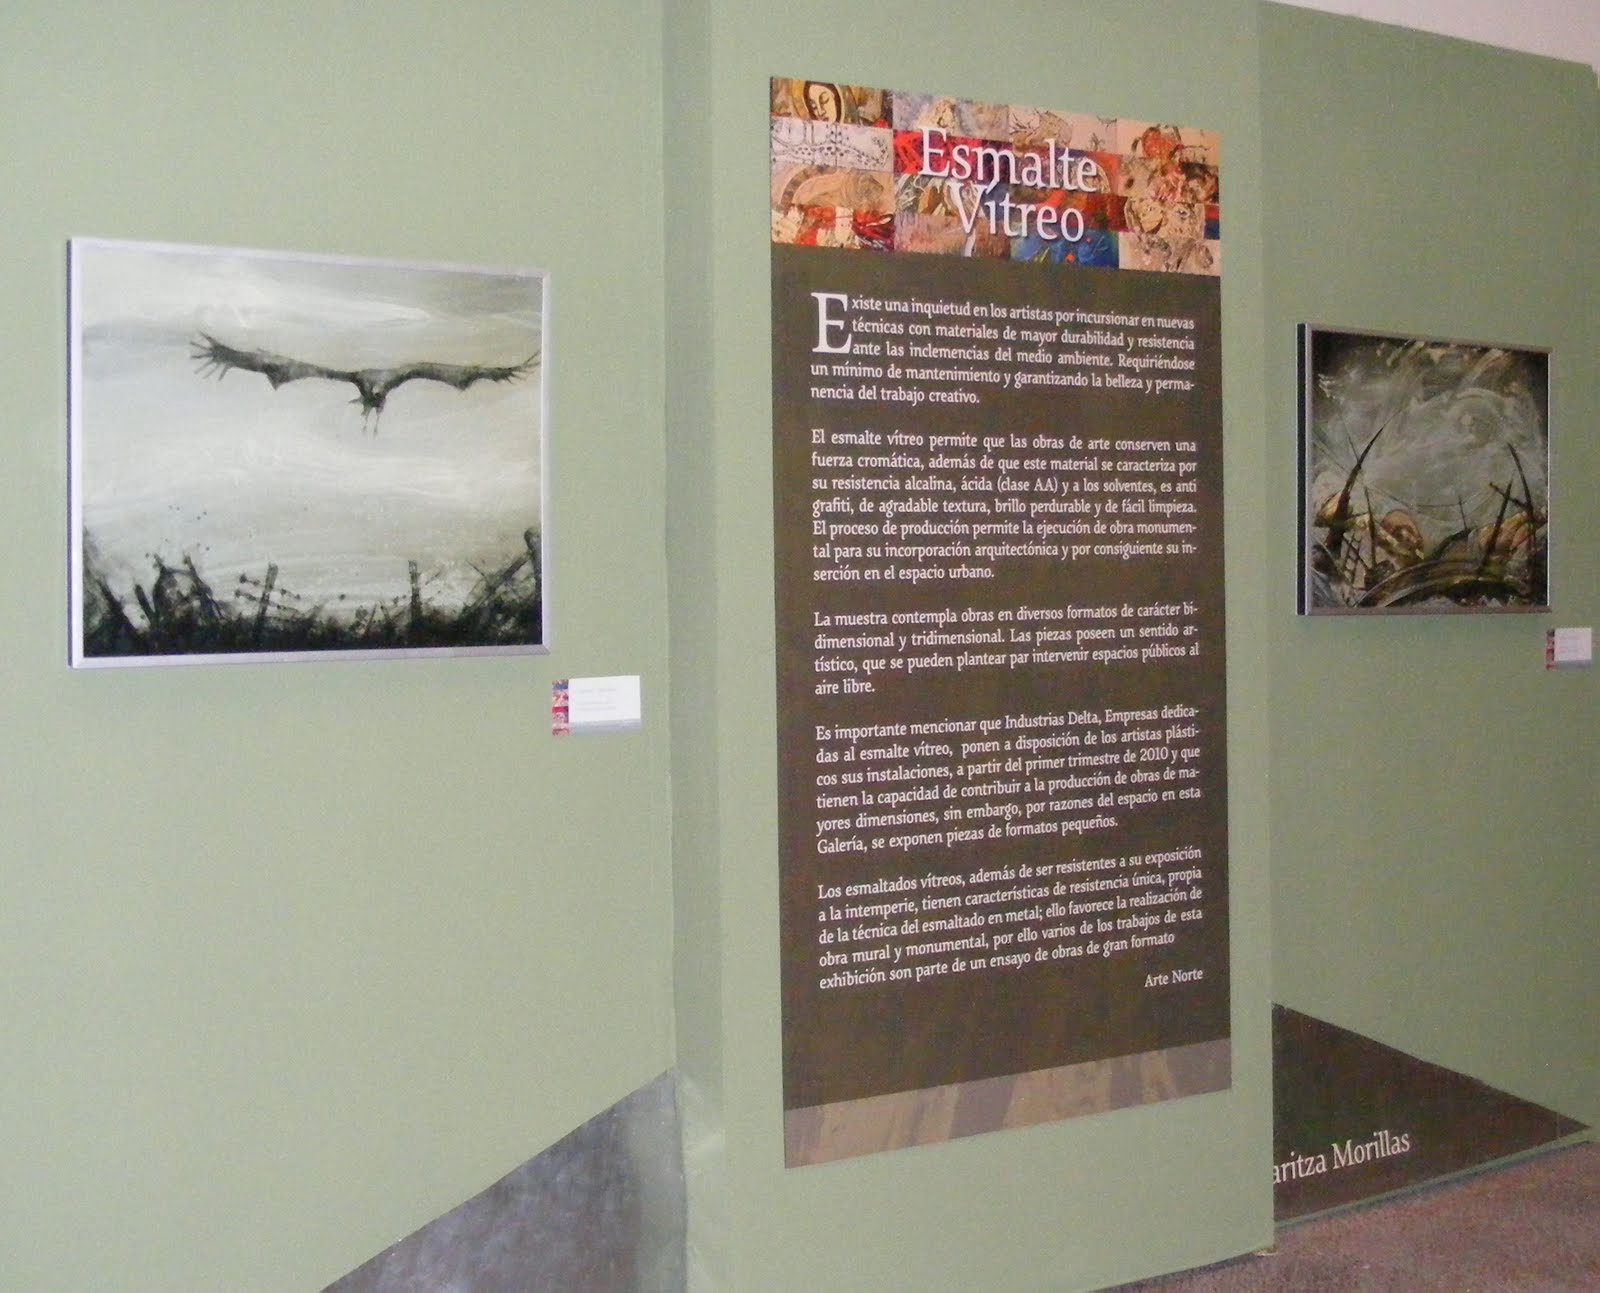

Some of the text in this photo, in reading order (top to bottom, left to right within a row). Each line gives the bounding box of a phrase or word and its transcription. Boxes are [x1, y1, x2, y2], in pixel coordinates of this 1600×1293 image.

[918, 127, 1097, 193] Esmalte
[884, 300, 909, 312] una
[911, 299, 970, 318] inquietud
[973, 305, 988, 316] en
[991, 302, 1007, 318] los
[1009, 306, 1053, 321] artistas
[1054, 311, 1075, 326] por
[1076, 308, 1139, 326] incursionar
[1141, 316, 1155, 327] en
[1156, 318, 1194, 329] nuevas
[852, 316, 1194, 351] técnicas con materiales de mayor durabilidad y resistencia
[852, 341, 1195, 372] ante las inclemencias del medio ambiente. Requiriéndose
[810, 364, 828, 375] un
[832, 361, 882, 377] mínimo
[887, 364, 901, 378] de
[905, 367, 1000, 382] mantenimiento
[1004, 373, 1011, 388] y
[1014, 370, 1088, 388] garantizando
[1091, 372, 1102, 386] la
[1105, 373, 1143, 388] belleza
[1146, 379, 1152, 393] y
[810, 384, 979, 406] nencia del trabajo creativo.
[811, 429, 1196, 452] El esmalte vítreo permite que las obras de arte conserven una
[811, 452, 1197, 476] fuerza cromática, además de que este material se caracteriza por
[812, 520, 826, 535] El
[829, 524, 878, 540] proceso
[882, 520, 897, 534] de
[900, 520, 969, 540] producción
[972, 520, 1019, 539] permite
[1023, 520, 1033, 534] la
[1037, 519, 1090, 539] ejecución
[1093, 520, 1106, 534] de
[1110, 520, 1133, 533] obra
[813, 564, 994, 584] serción en el espacio urbano.
[814, 612, 831, 626] La
[834, 612, 888, 625] muestra
[892, 608, 957, 628] contempla
[961, 607, 994, 622] obras
[998, 610, 1013, 621] en
[1017, 606, 1063, 620] diversos
[1067, 605, 1117, 619] formatos
[1121, 603, 1133, 617] de
[1137, 602, 1180, 616] carácter
[814, 642, 1199, 675] tístico, que se pueden plantear par intervenir espacios públicos al
[815, 679, 875, 694] aire libre.
[815, 725, 831, 740] Es
[834, 723, 906, 743] importante
[909, 721, 976, 734] mencionar
[979, 719, 1001, 735] que
[1005, 714, 1064, 728] Industrias
[1068, 710, 1101, 725] Delta,
[1105, 709, 1158, 726] Empresas
[816, 746, 1200, 786] cos sus instalaciones, a partir del primer trimestre de 2010 y que
[817, 814, 1118, 853] Galería, se exponen piezas de formatos pequeños.
[817, 846, 1201, 899] Los esmaltados vítreos, además de ser resistentes a su exposición
[819, 909, 1202, 966] obra mural y monumental, por ello varios de los trabajos de esta
[1144, 969, 1203, 987] Arte Norte
[1331, 1129, 1411, 1170] Morillas
